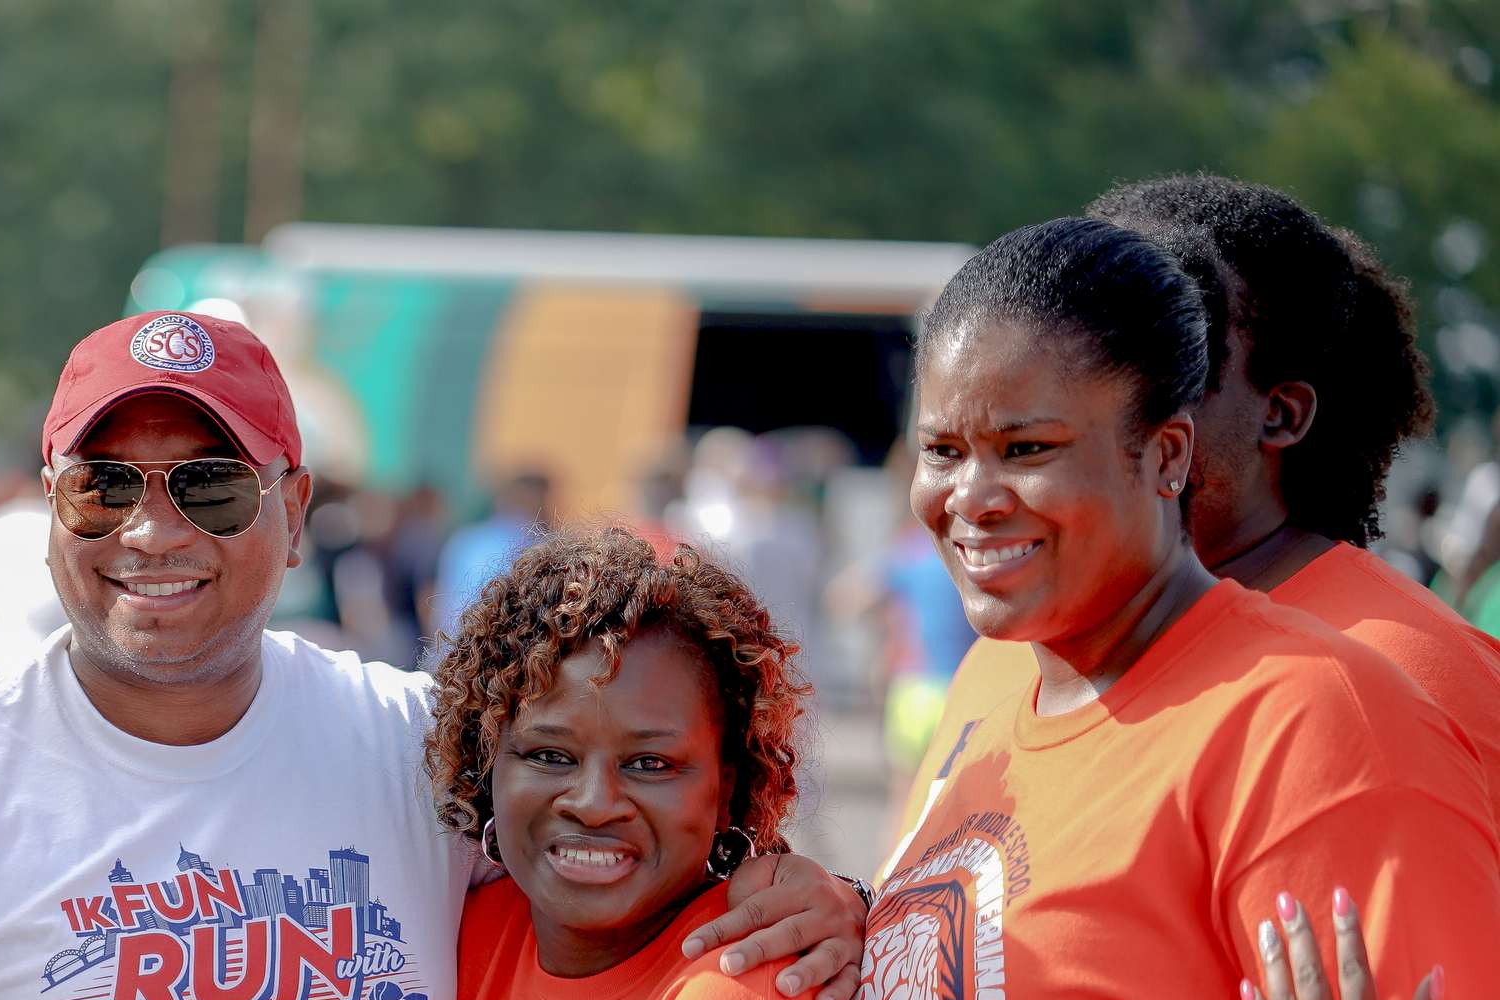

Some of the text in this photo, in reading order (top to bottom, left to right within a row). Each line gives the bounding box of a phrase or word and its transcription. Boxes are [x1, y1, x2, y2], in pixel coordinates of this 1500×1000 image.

[149, 326, 199, 360] SCS
[60, 868, 248, 936] 1K FUN
[336, 943, 405, 980] with
